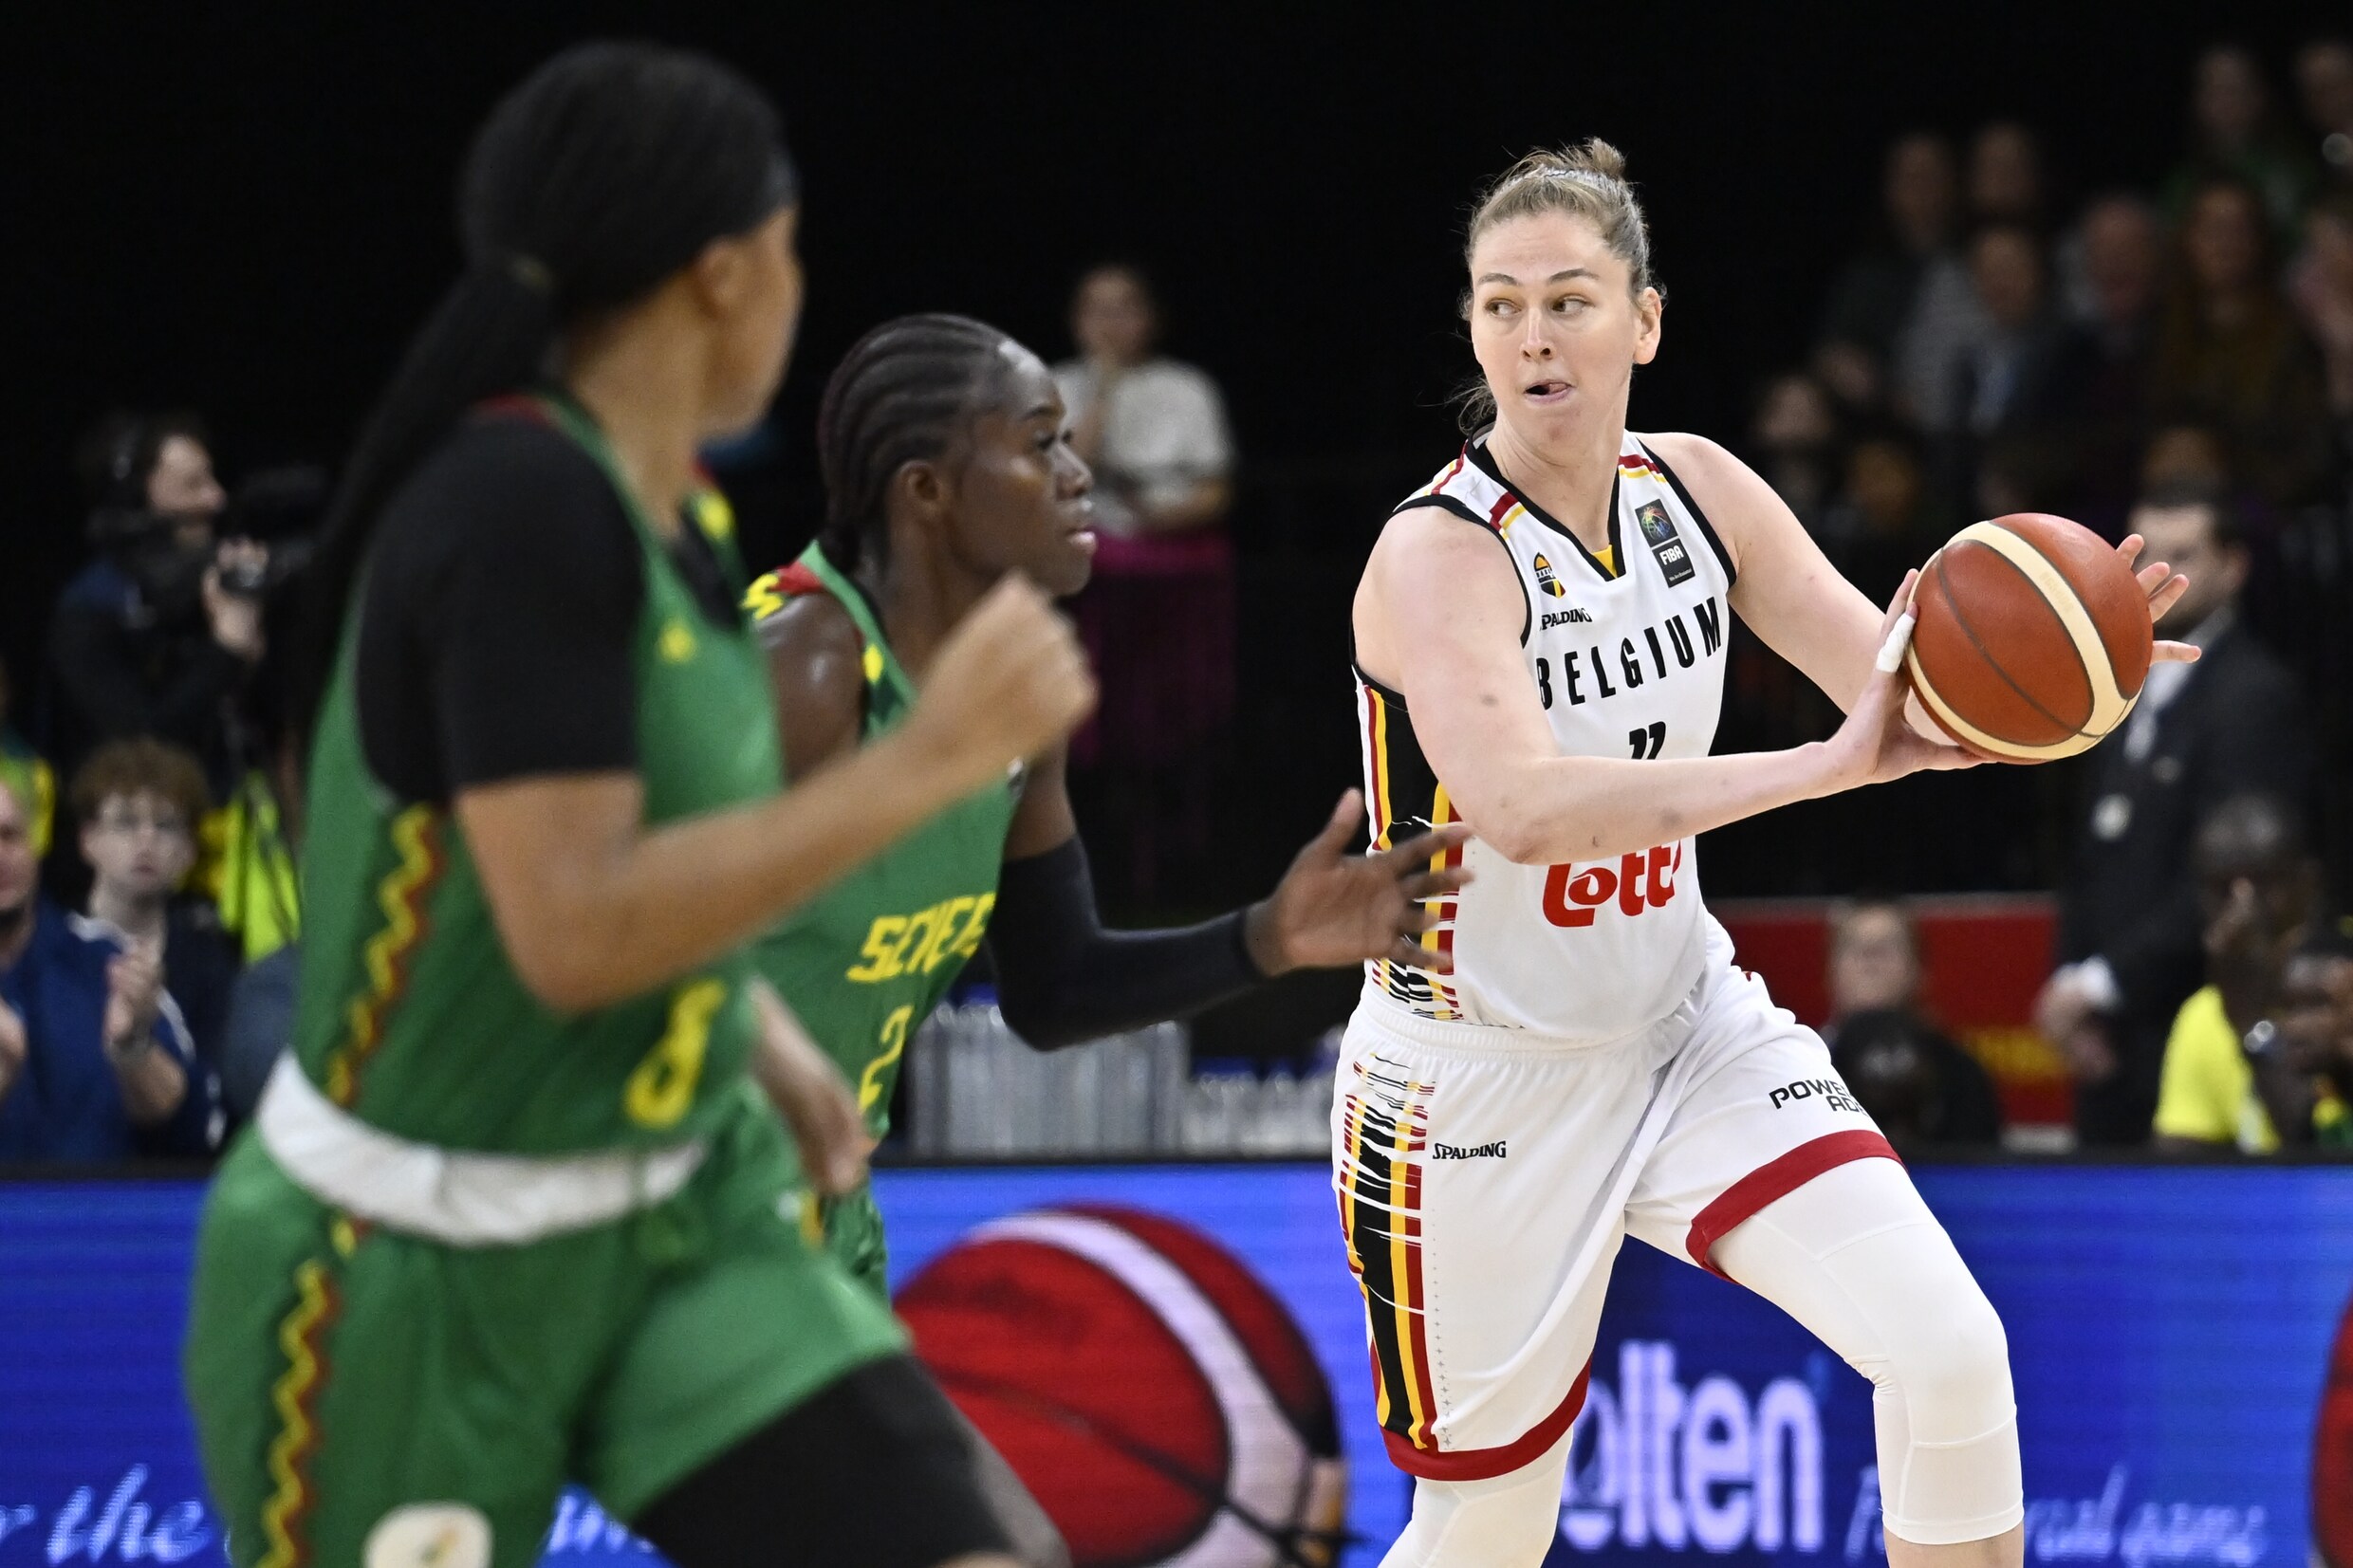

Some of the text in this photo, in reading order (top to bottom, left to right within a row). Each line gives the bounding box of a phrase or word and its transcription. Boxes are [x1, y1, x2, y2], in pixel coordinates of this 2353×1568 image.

[1659, 545, 1684, 565] FIBA
[1536, 597, 1722, 710] BELGIUM
[1540, 607, 1593, 632] PALDING
[1543, 839, 1681, 928] Lott
[859, 1005, 914, 1111] 2
[1769, 1079, 1852, 1110] POWE
[1432, 1140, 1507, 1159] SPALDING
[1561, 1339, 1823, 1554] olten
[46, 1463, 214, 1565] the
